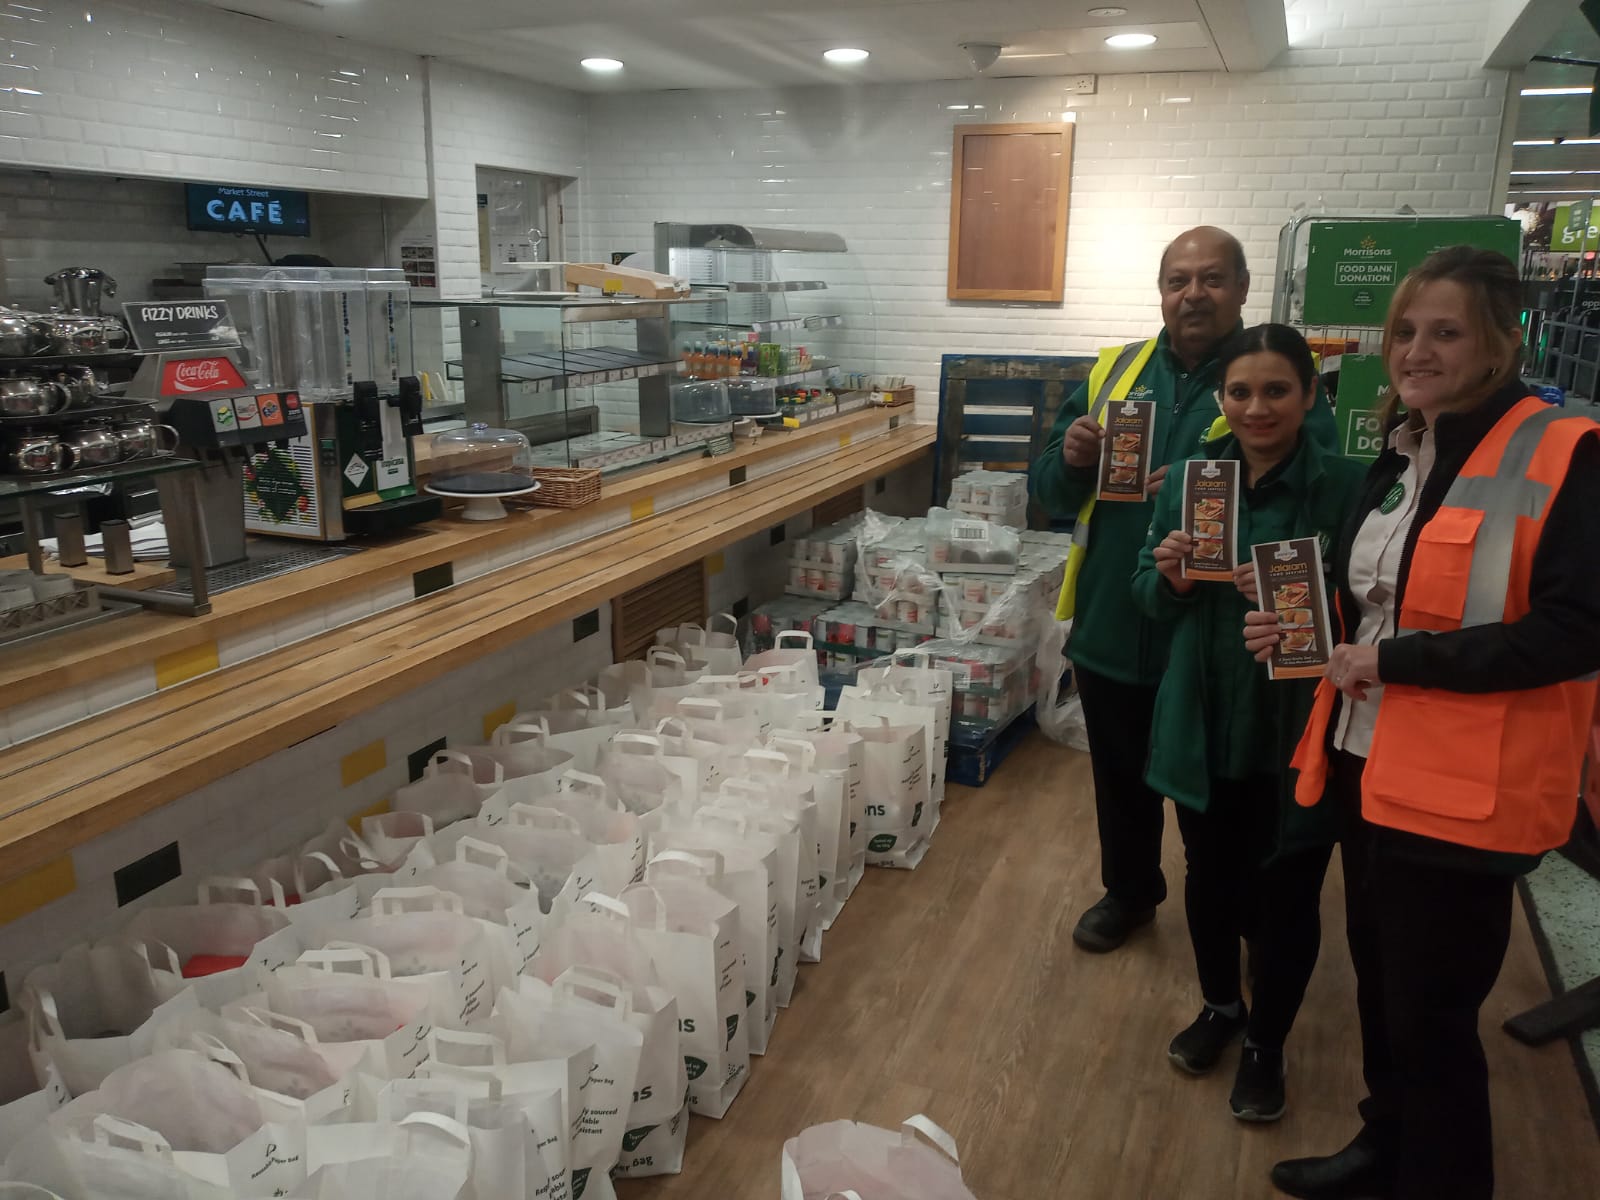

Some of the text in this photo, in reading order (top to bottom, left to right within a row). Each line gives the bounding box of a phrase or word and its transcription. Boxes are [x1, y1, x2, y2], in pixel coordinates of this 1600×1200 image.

[218, 187, 269, 197] Market Street
[206, 199, 283, 224] CAFÉ
[1343, 247, 1392, 256] Morrisons
[1339, 265, 1392, 273] FOOD BANK
[1340, 274, 1390, 282] DONATION
[141, 305, 219, 322] FIZZY DRINKS
[590, 1107, 618, 1115] sourced
